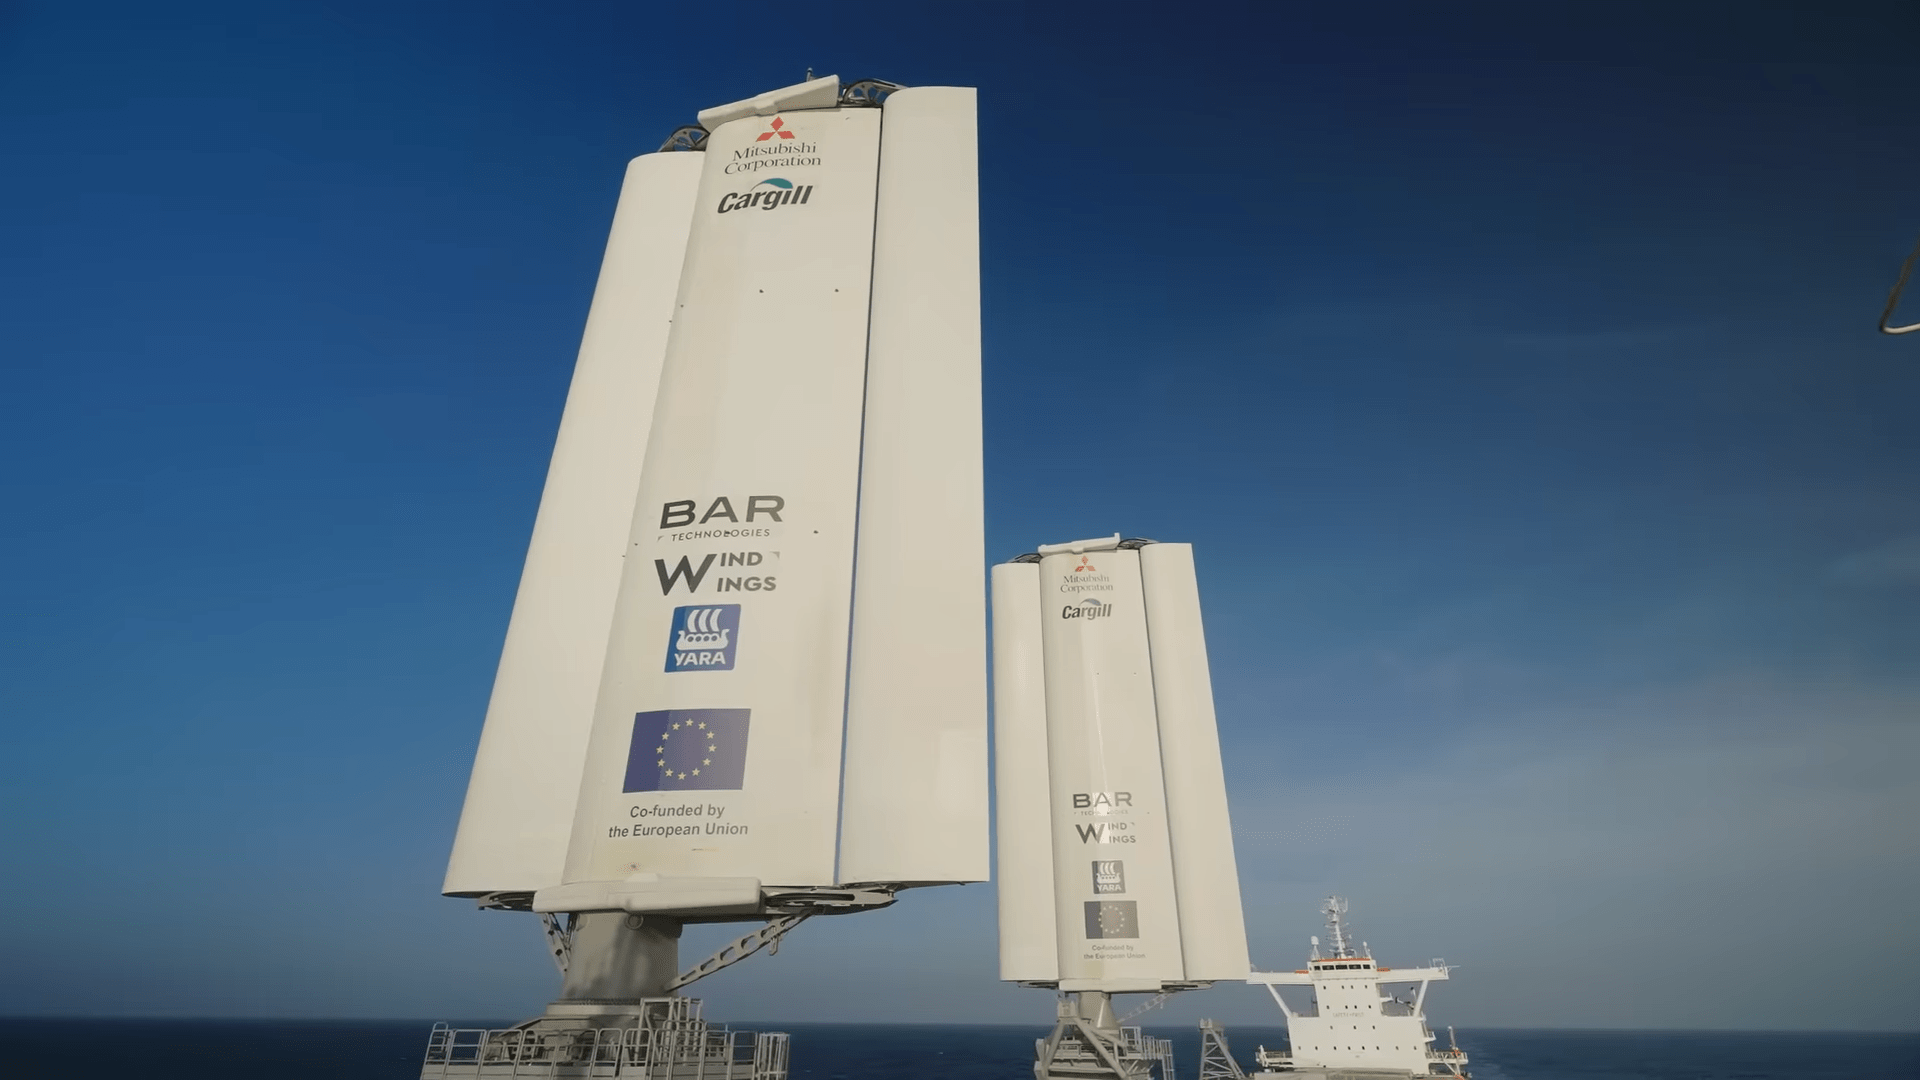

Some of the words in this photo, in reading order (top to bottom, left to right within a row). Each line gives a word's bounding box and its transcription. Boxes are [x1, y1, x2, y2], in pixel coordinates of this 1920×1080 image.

[733, 142, 817, 161] Mitsubishi
[724, 155, 821, 175] Corporation
[717, 185, 813, 214] Cargill
[660, 495, 785, 530] BAR
[671, 528, 771, 542] TECHNOLOGIES
[1062, 603, 1112, 620] Cargill
[674, 651, 726, 666] YARA
[1073, 791, 1133, 809] BAR
[630, 804, 703, 818] Co-funded
[707, 803, 725, 819] by
[608, 825, 629, 838] the
[632, 823, 700, 838] European
[705, 822, 749, 835] Union
[1097, 884, 1122, 892] YARA
